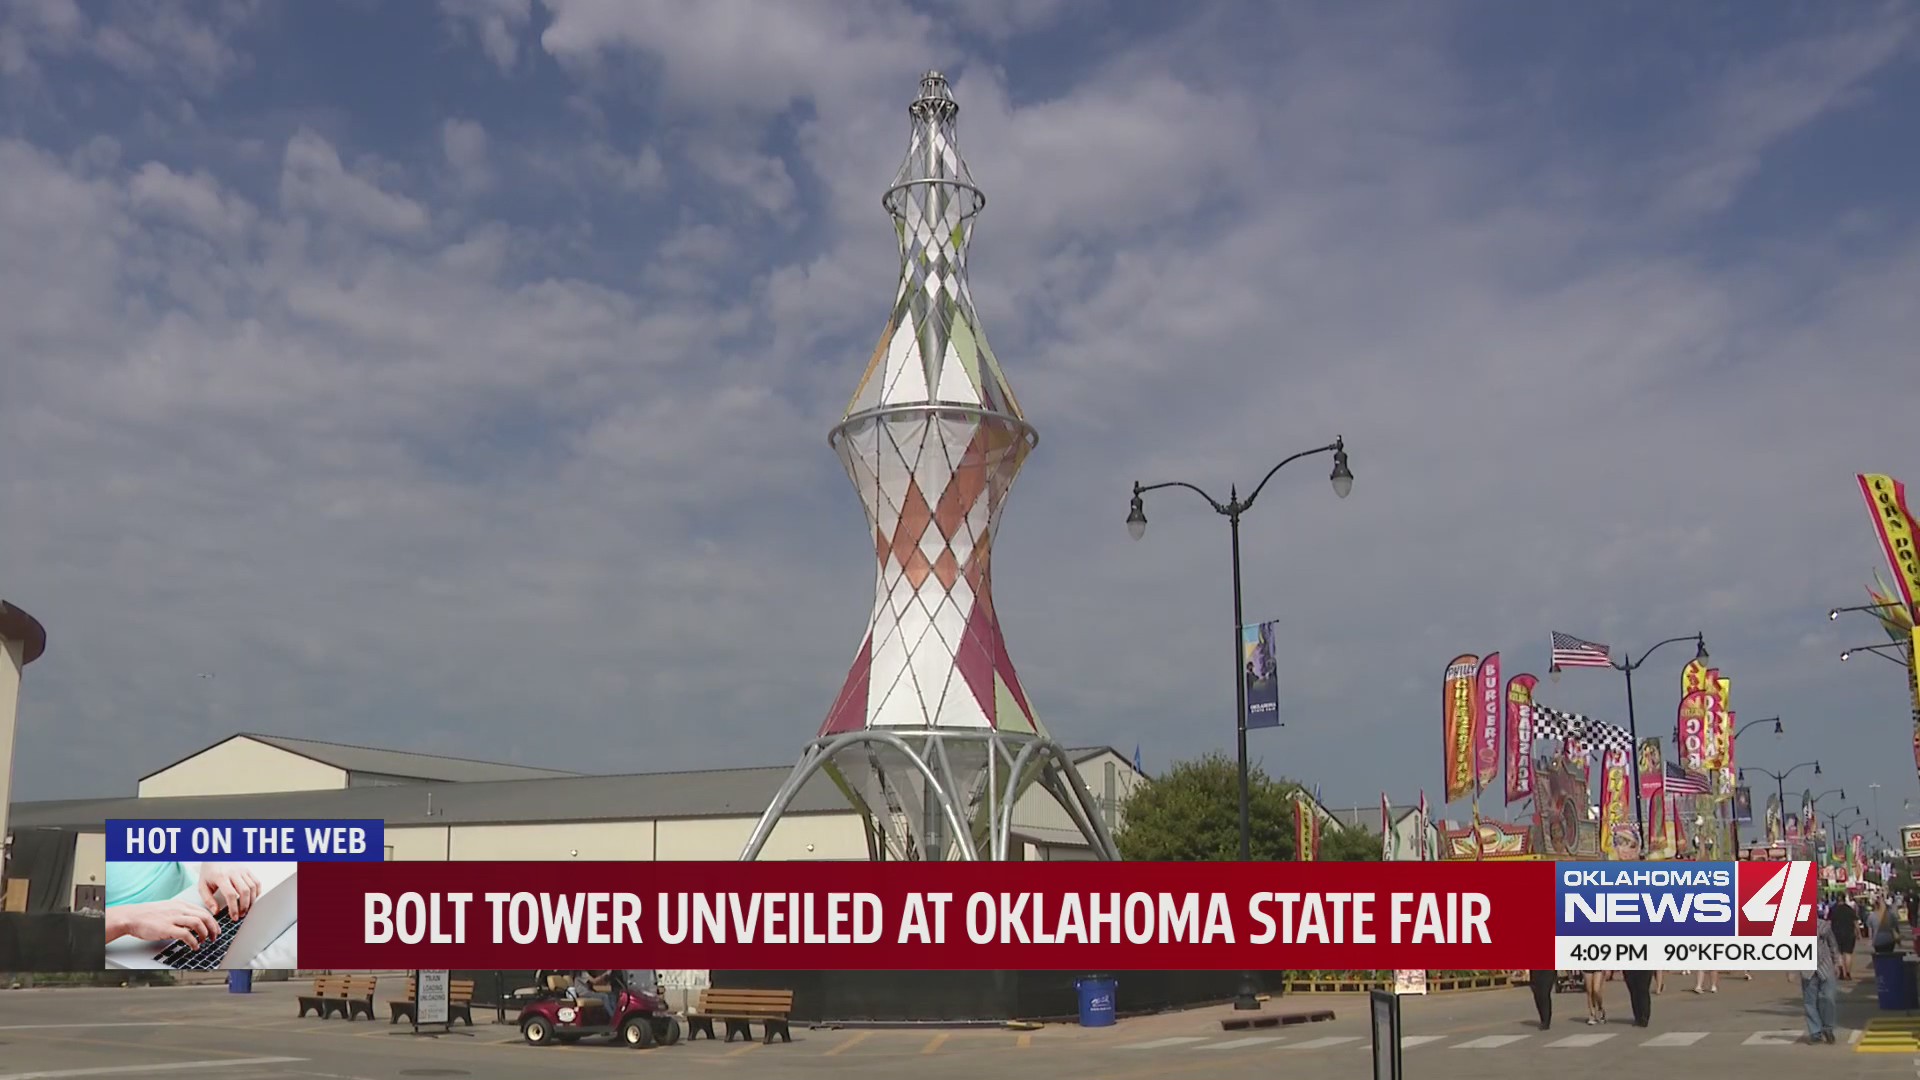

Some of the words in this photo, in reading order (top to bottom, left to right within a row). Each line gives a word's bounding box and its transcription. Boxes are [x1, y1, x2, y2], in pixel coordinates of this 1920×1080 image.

[1874, 478, 1902, 531] CORN
[1447, 665, 1476, 678] PHILLY
[1485, 664, 1497, 749] BURGERS
